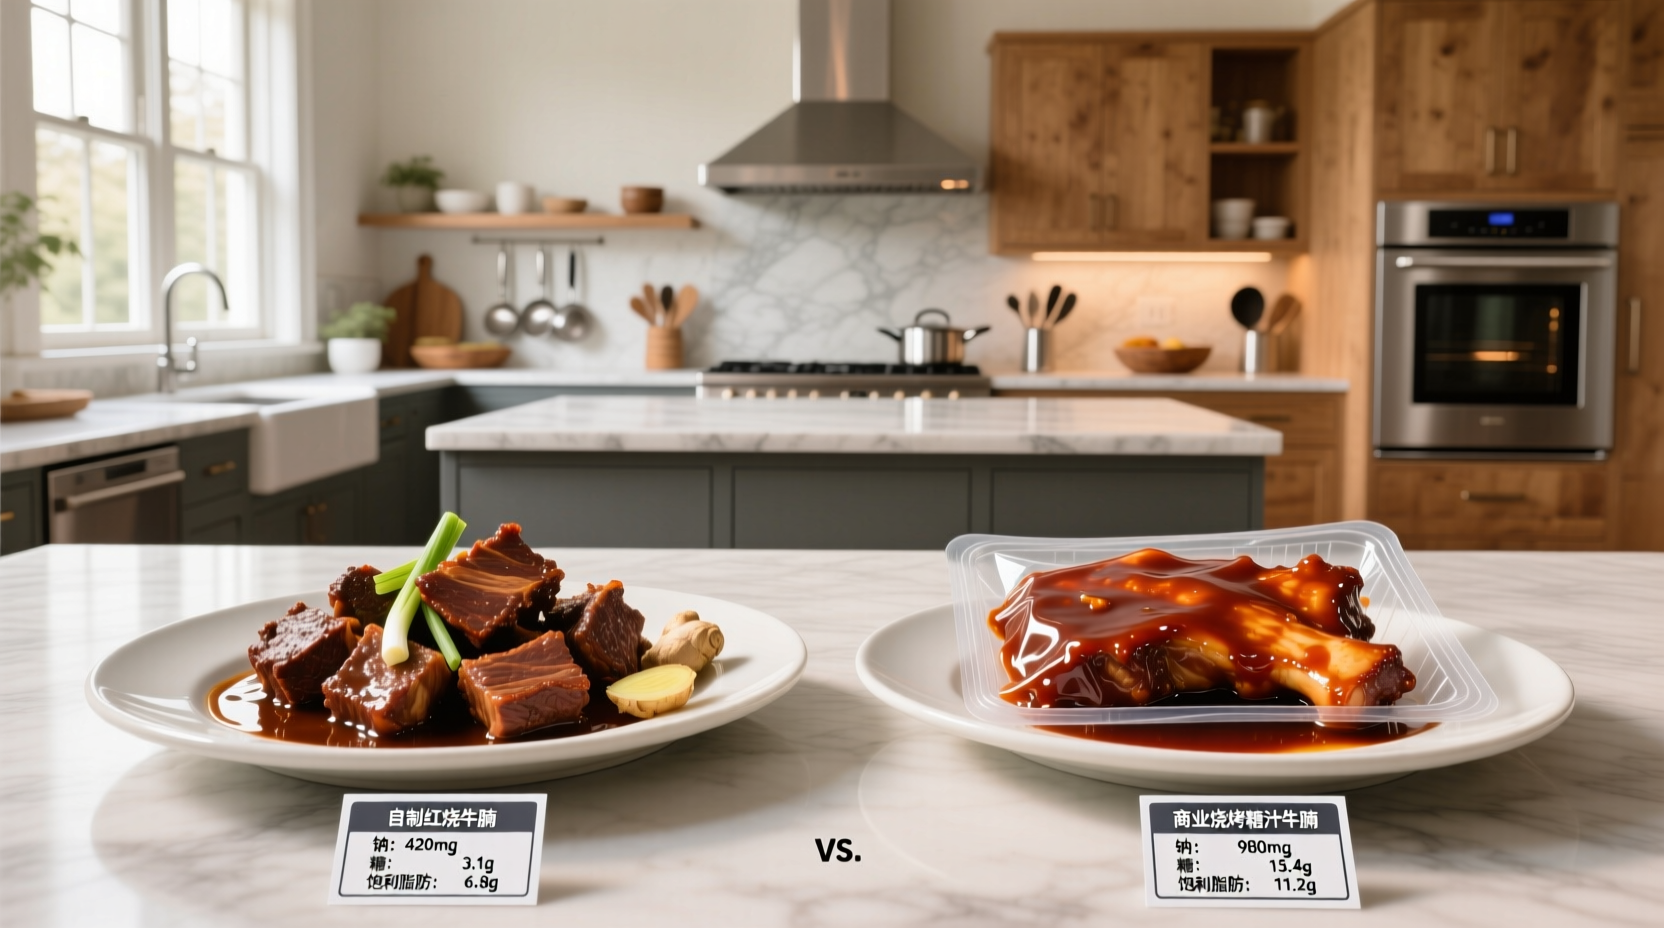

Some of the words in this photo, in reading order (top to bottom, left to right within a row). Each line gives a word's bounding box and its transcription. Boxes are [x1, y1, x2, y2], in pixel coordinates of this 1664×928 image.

[404, 837, 458, 856] 420mg
[1237, 839, 1292, 858] 980mg
[462, 856, 495, 874] 3.1g
[1269, 858, 1312, 877] 15.4g
[464, 875, 499, 893] 6.8g
[1274, 877, 1317, 896] 11.2g
